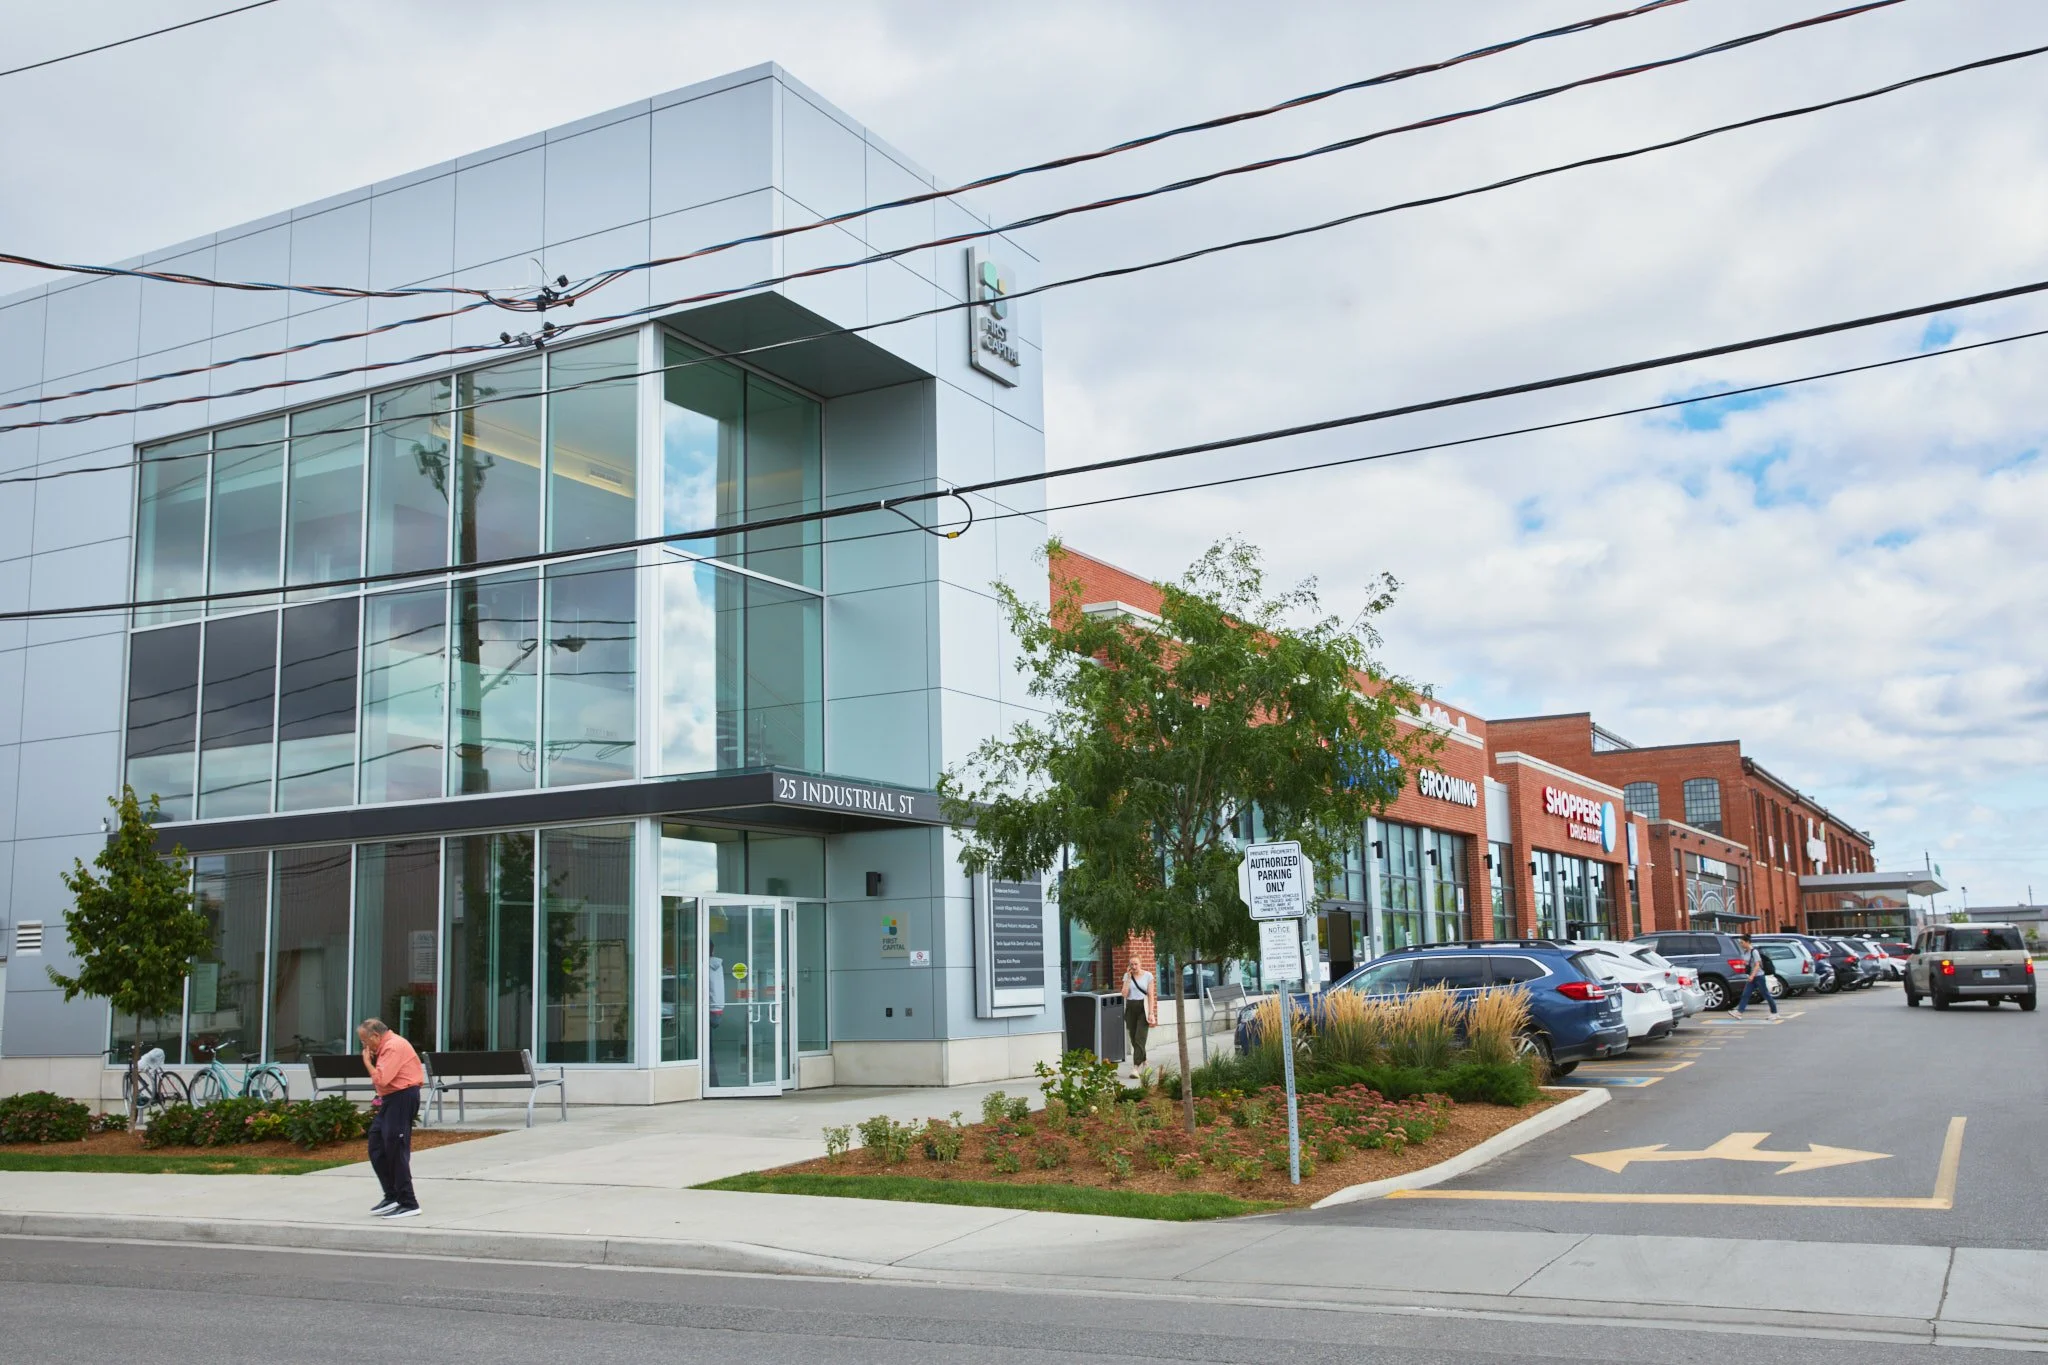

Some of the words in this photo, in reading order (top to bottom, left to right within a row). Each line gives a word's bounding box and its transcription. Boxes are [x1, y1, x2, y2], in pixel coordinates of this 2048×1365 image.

[982, 317, 1006, 341] FIRST
[779, 777, 796, 800] 25
[802, 781, 895, 812] INDUSTRIAL
[899, 794, 915, 815] ST
[1418, 767, 1478, 808] GROOMING
[1544, 785, 1603, 827] SHOPPERS
[1569, 822, 1587, 842] DRUG
[1587, 826, 1603, 845] MART
[1250, 855, 1298, 869] AUTHORIZED
[1257, 868, 1292, 881] PARKING
[1265, 881, 1285, 893] ONLY
[882, 943, 905, 951] CAPITAL
